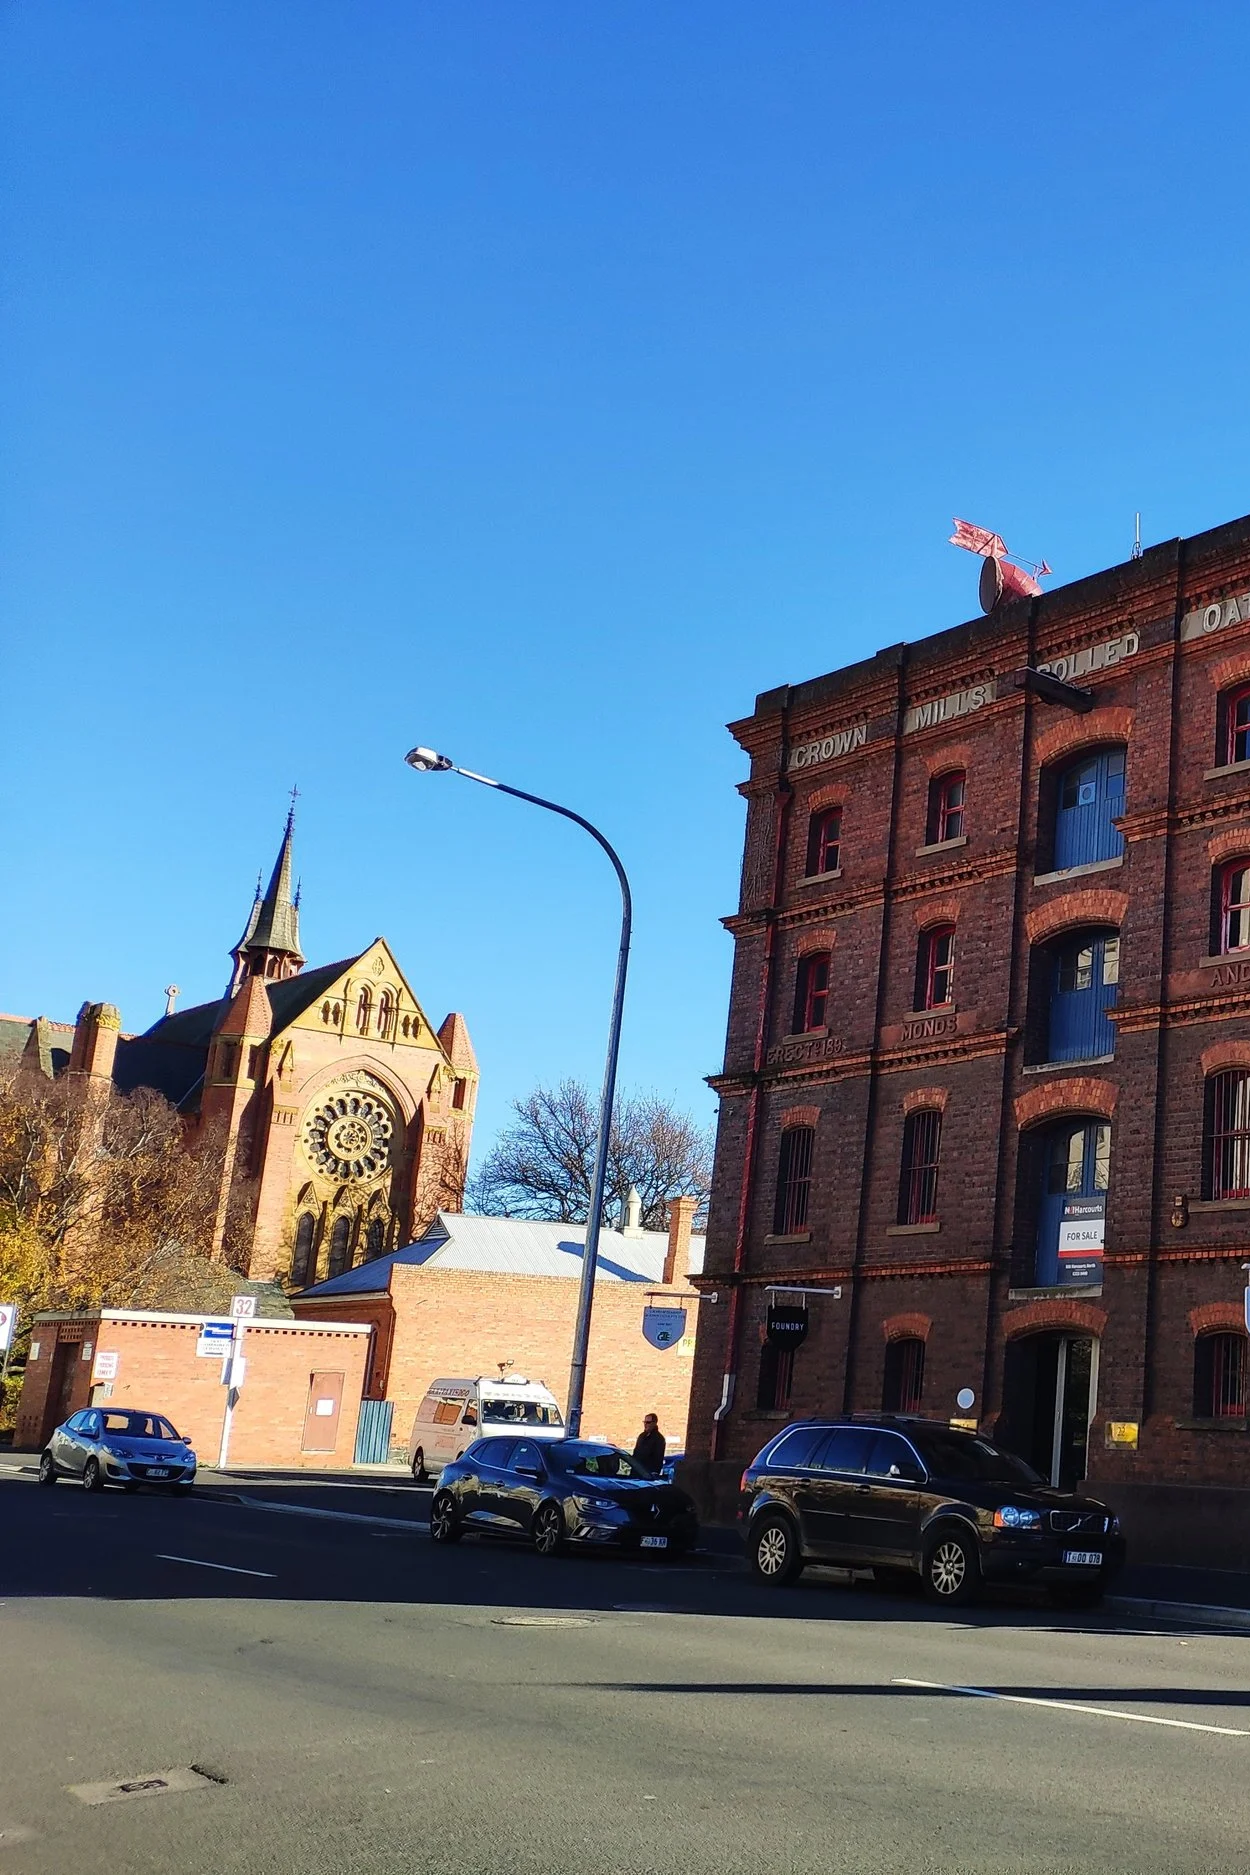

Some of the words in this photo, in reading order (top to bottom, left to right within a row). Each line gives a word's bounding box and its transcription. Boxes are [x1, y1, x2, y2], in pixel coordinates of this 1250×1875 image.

[794, 725, 868, 768] CROWN
[915, 686, 986, 730] MILLS
[900, 1016, 957, 1042] MONDS
[1066, 1232, 1080, 1241] FOR
[1081, 1231, 1098, 1240] SALE
[235, 1299, 252, 1315] 32
[771, 1321, 804, 1331] FOUNDRY
